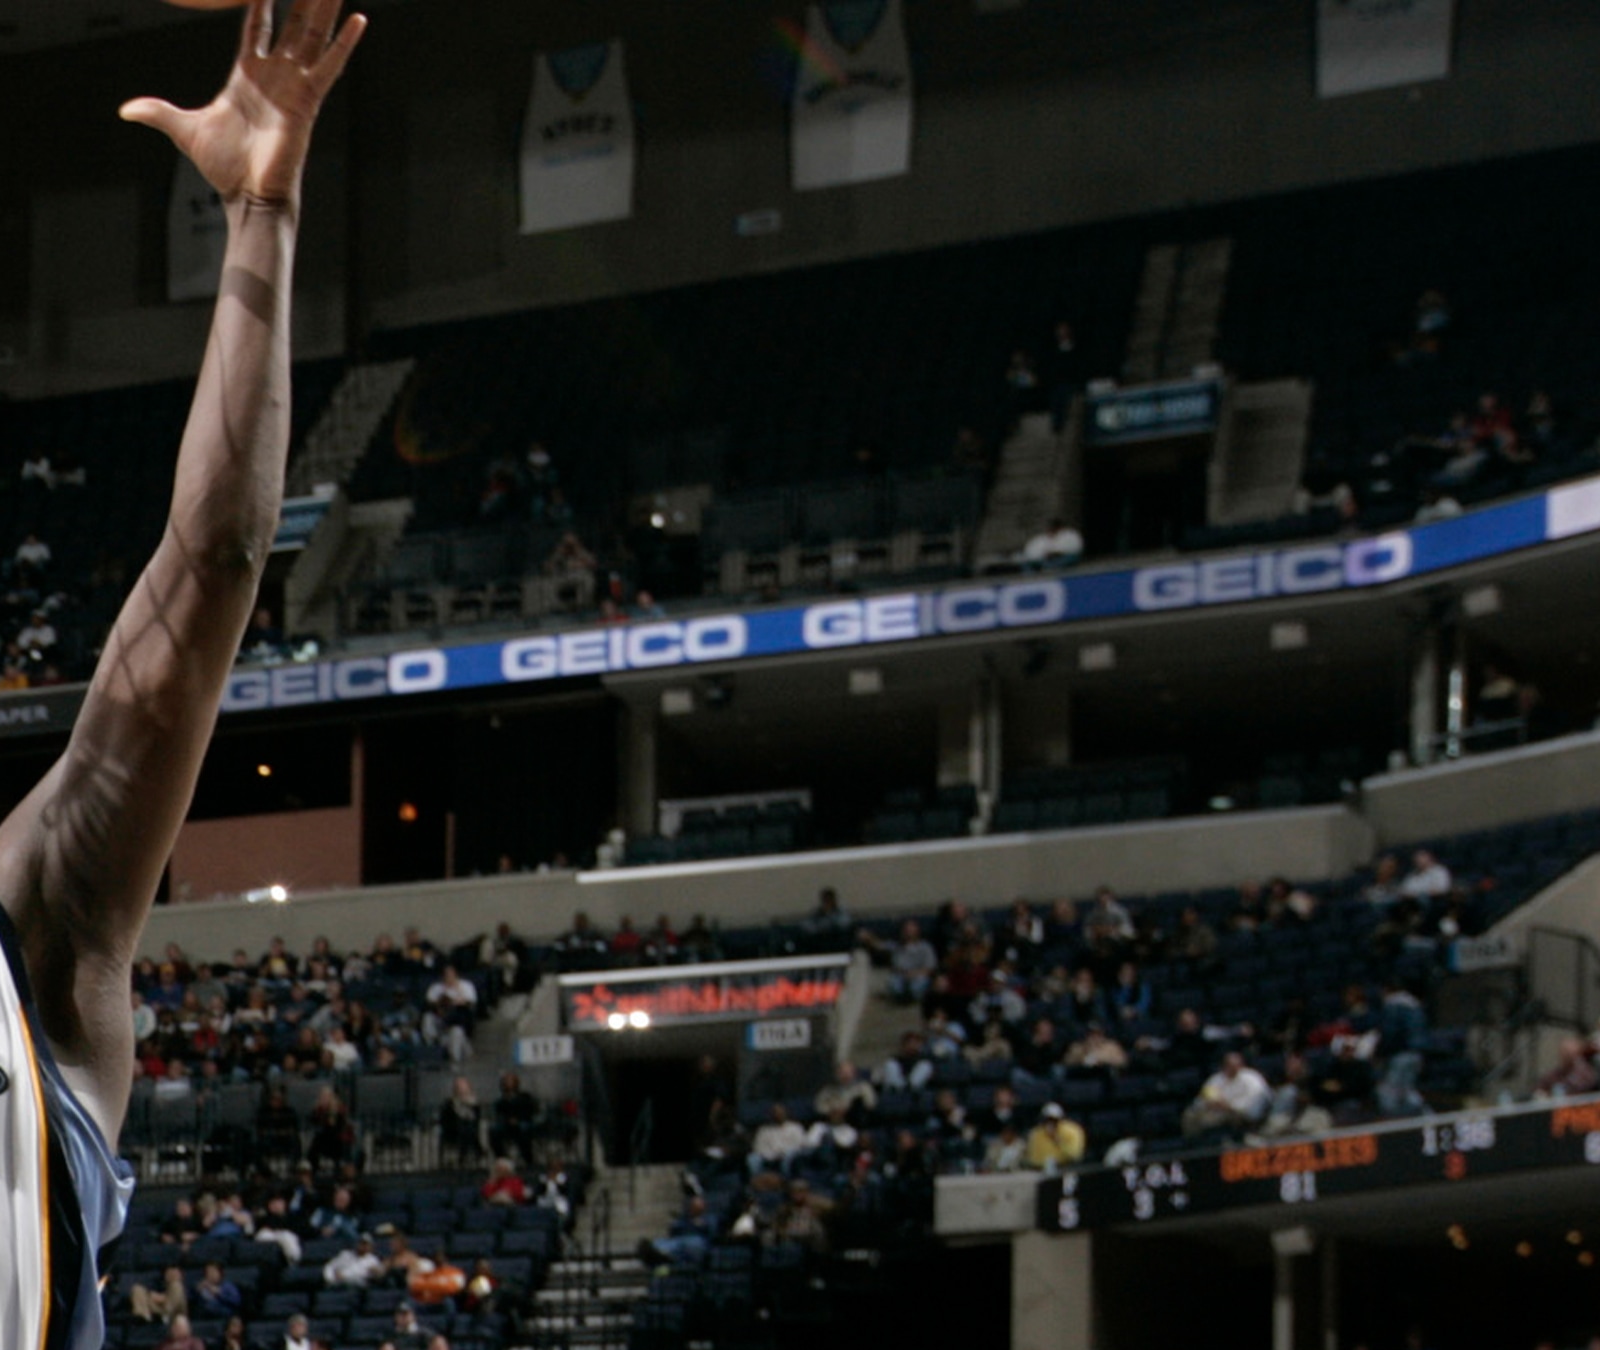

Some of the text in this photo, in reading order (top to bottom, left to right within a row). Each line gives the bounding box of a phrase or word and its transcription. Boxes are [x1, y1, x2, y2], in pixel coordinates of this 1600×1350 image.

[1133, 532, 1413, 611] GEICO
[502, 614, 748, 682] GEICO
[803, 582, 1066, 649] GEICO
[221, 650, 447, 713] GEICO
[1220, 1134, 1379, 1183] GRIZZLIES
